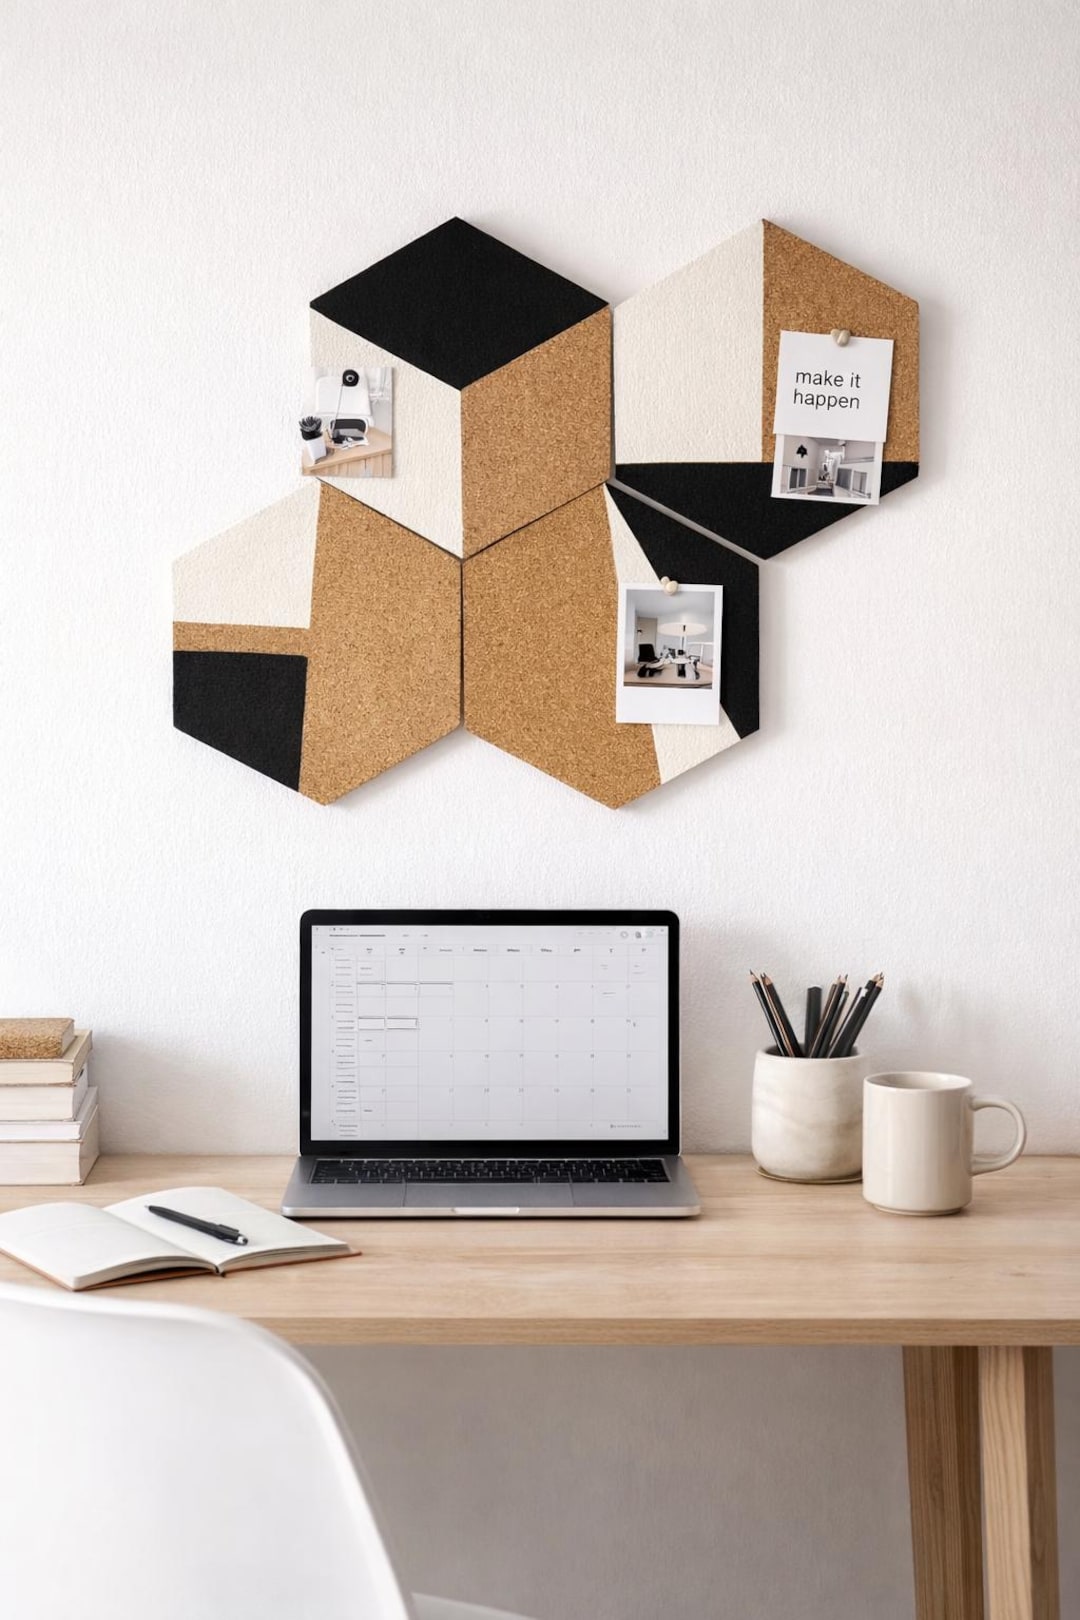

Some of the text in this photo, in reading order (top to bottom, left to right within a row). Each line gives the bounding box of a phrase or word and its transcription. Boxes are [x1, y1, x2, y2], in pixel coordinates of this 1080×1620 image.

[795, 370, 861, 389] make it
[793, 388, 860, 411] happen
